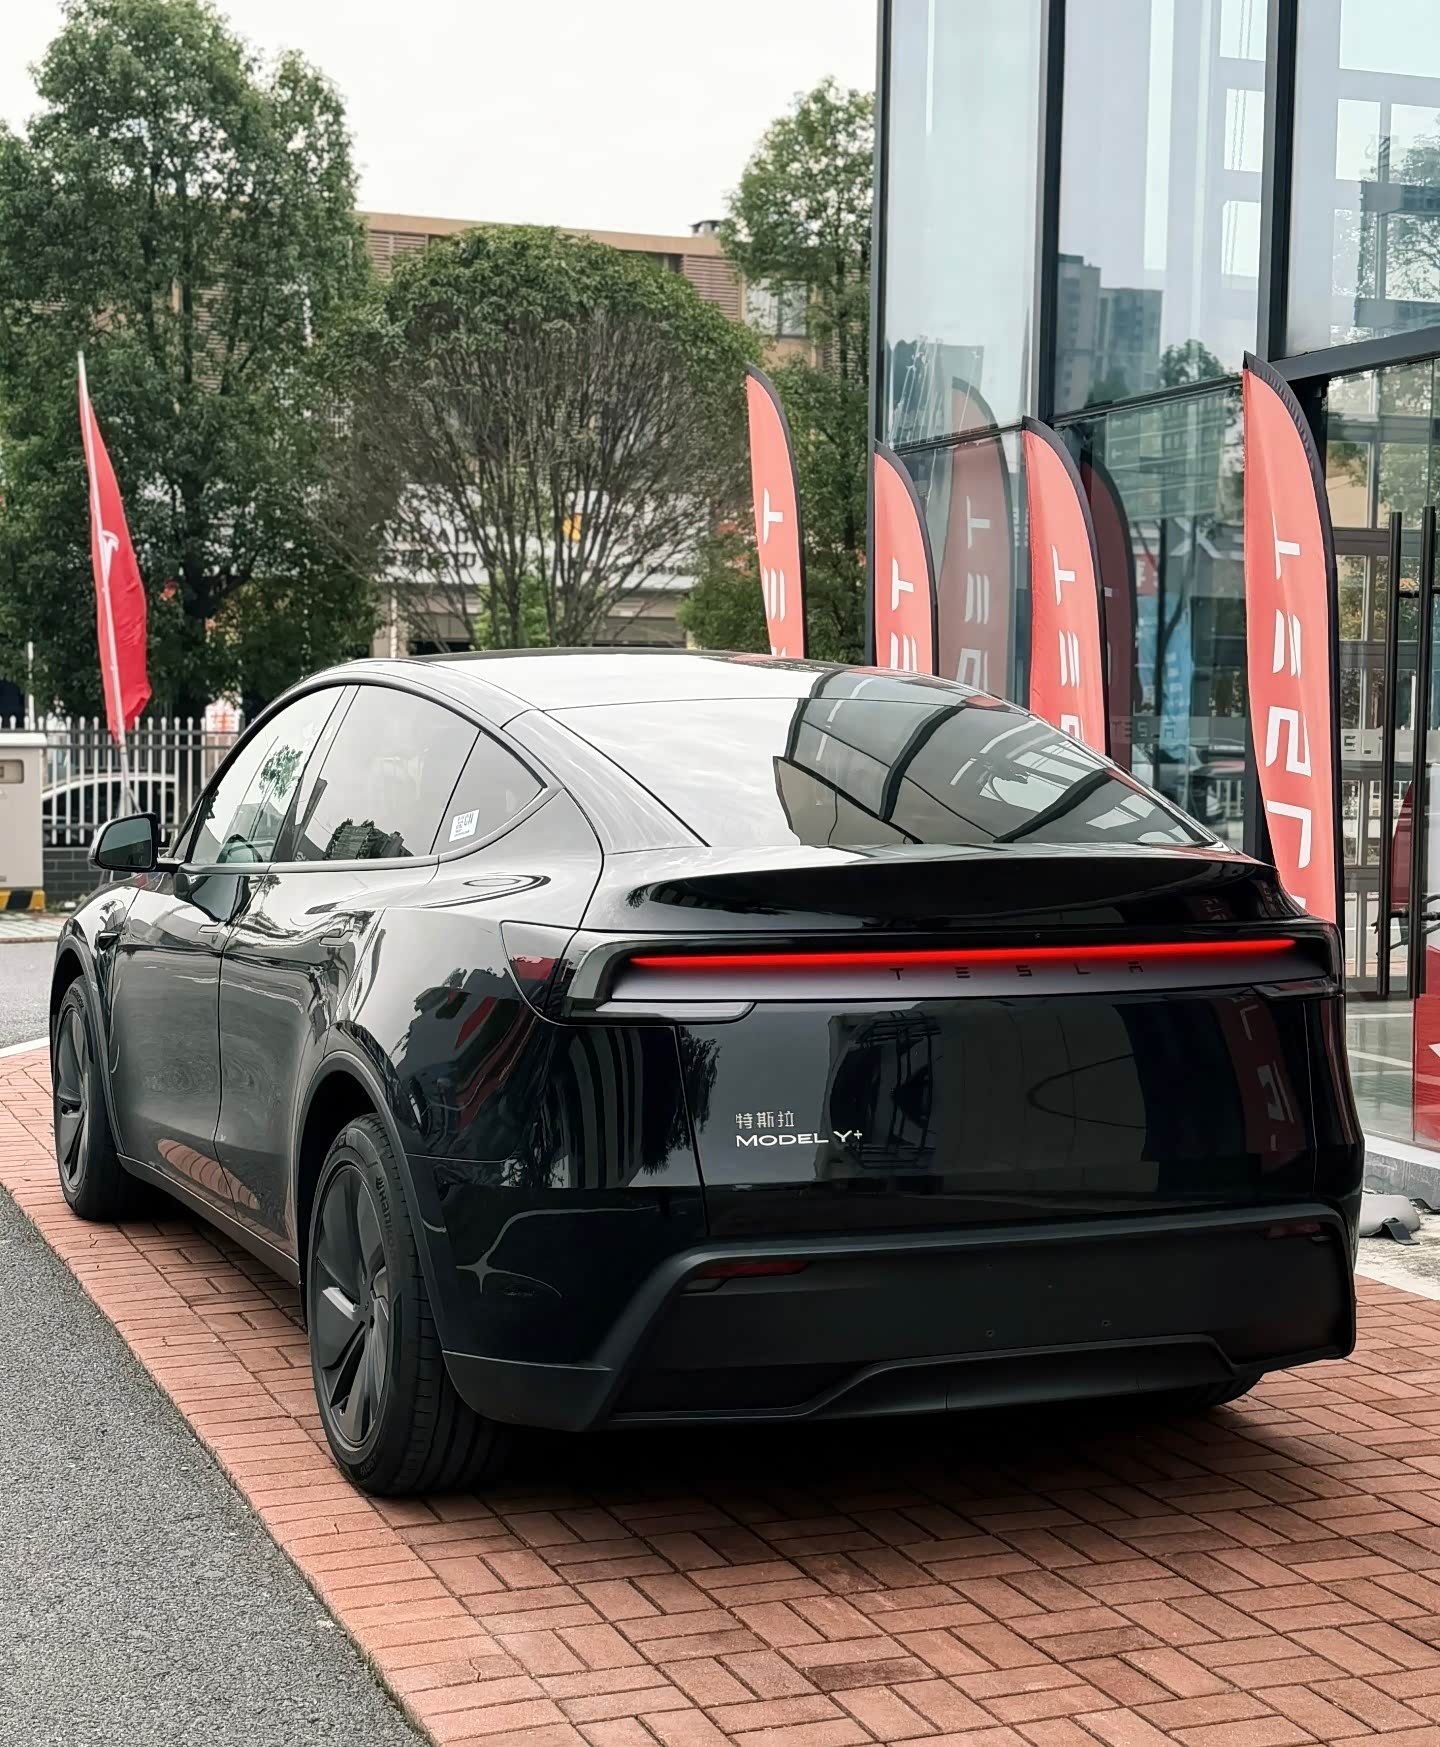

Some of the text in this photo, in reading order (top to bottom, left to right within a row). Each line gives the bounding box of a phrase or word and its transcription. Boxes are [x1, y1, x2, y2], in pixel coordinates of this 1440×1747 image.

[889, 961, 1144, 981] TESLA
[735, 1110, 795, 1129] 特斯拉
[736, 1129, 863, 1147] MODEL Y+
